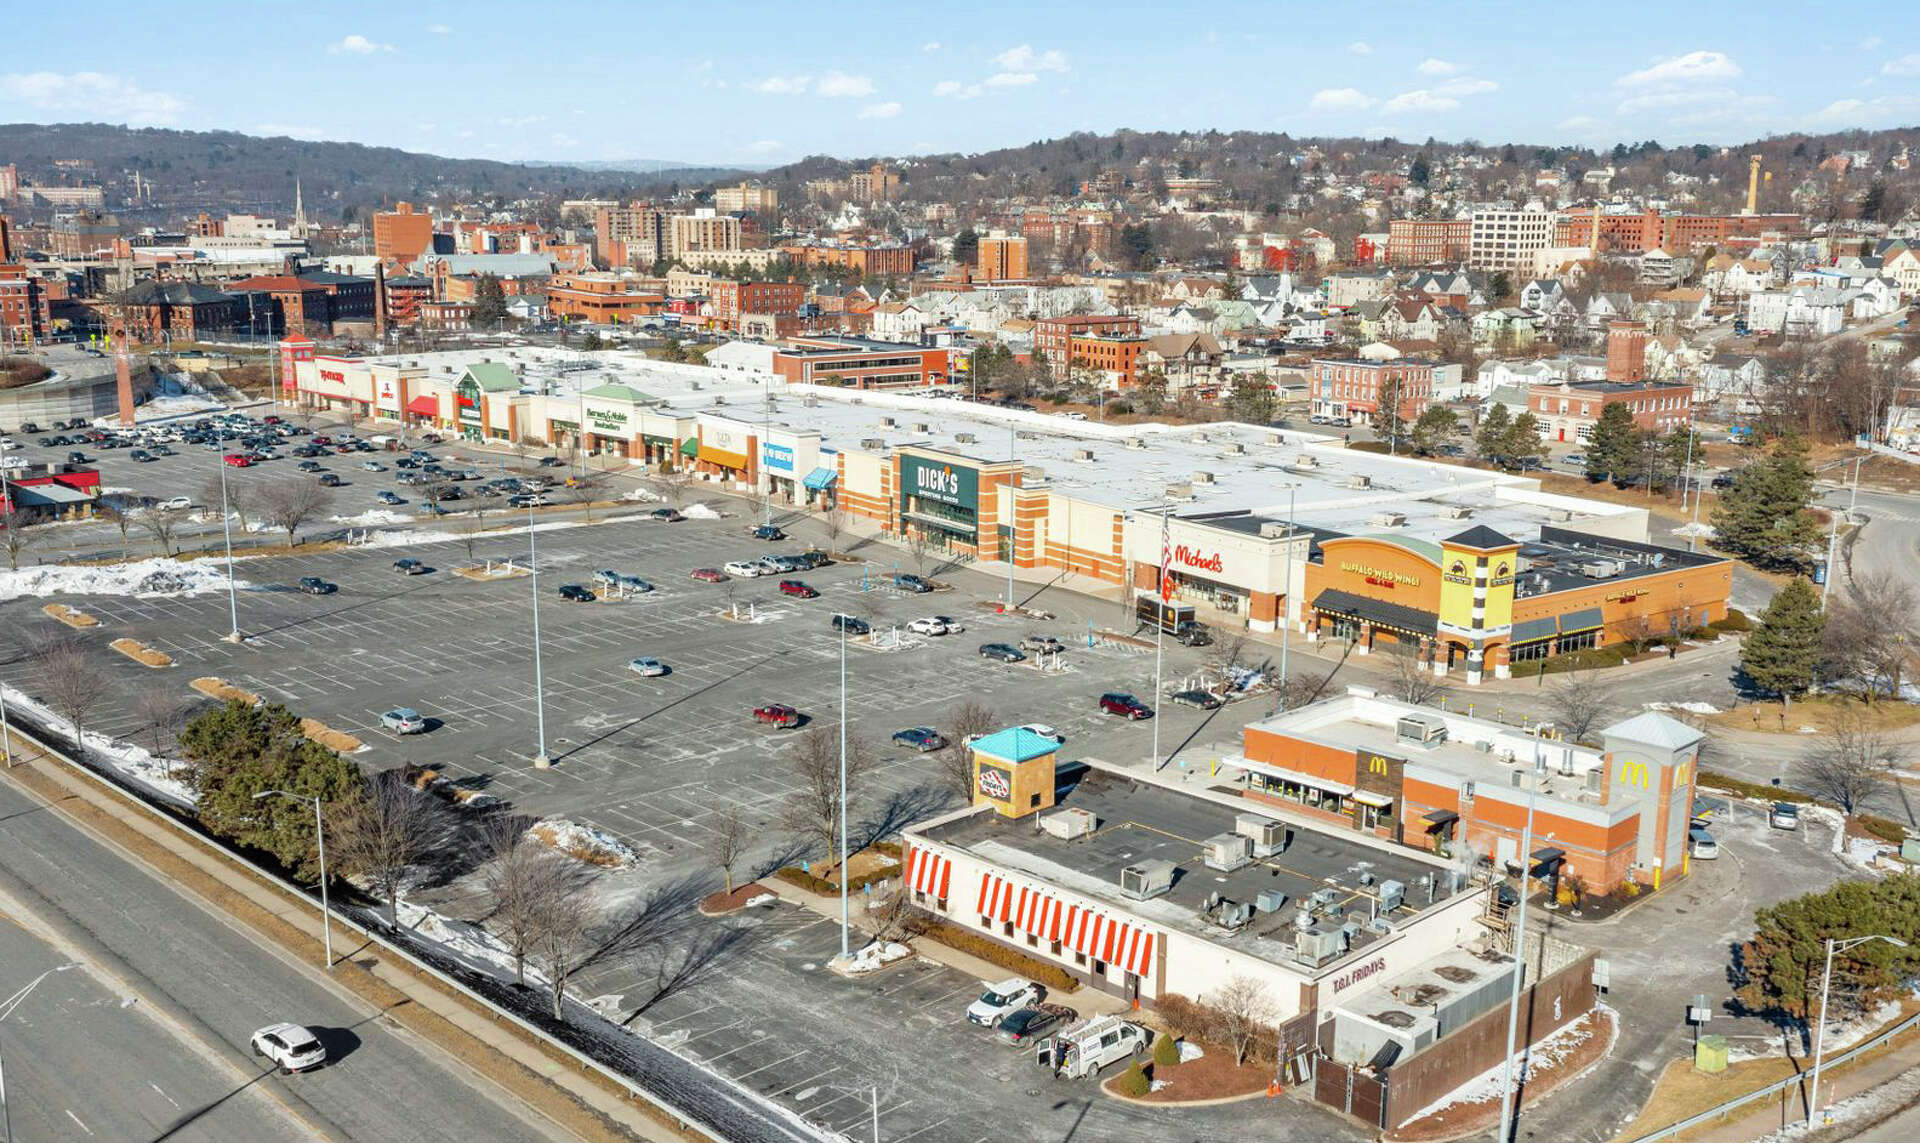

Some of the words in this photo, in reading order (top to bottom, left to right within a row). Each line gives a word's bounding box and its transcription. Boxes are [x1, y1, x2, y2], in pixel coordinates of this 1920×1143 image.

[917, 465, 958, 495] DICK'S
[1175, 544, 1223, 573] Michaels
[1340, 561, 1372, 575] BUFFALO
[1373, 567, 1394, 582] WILD
